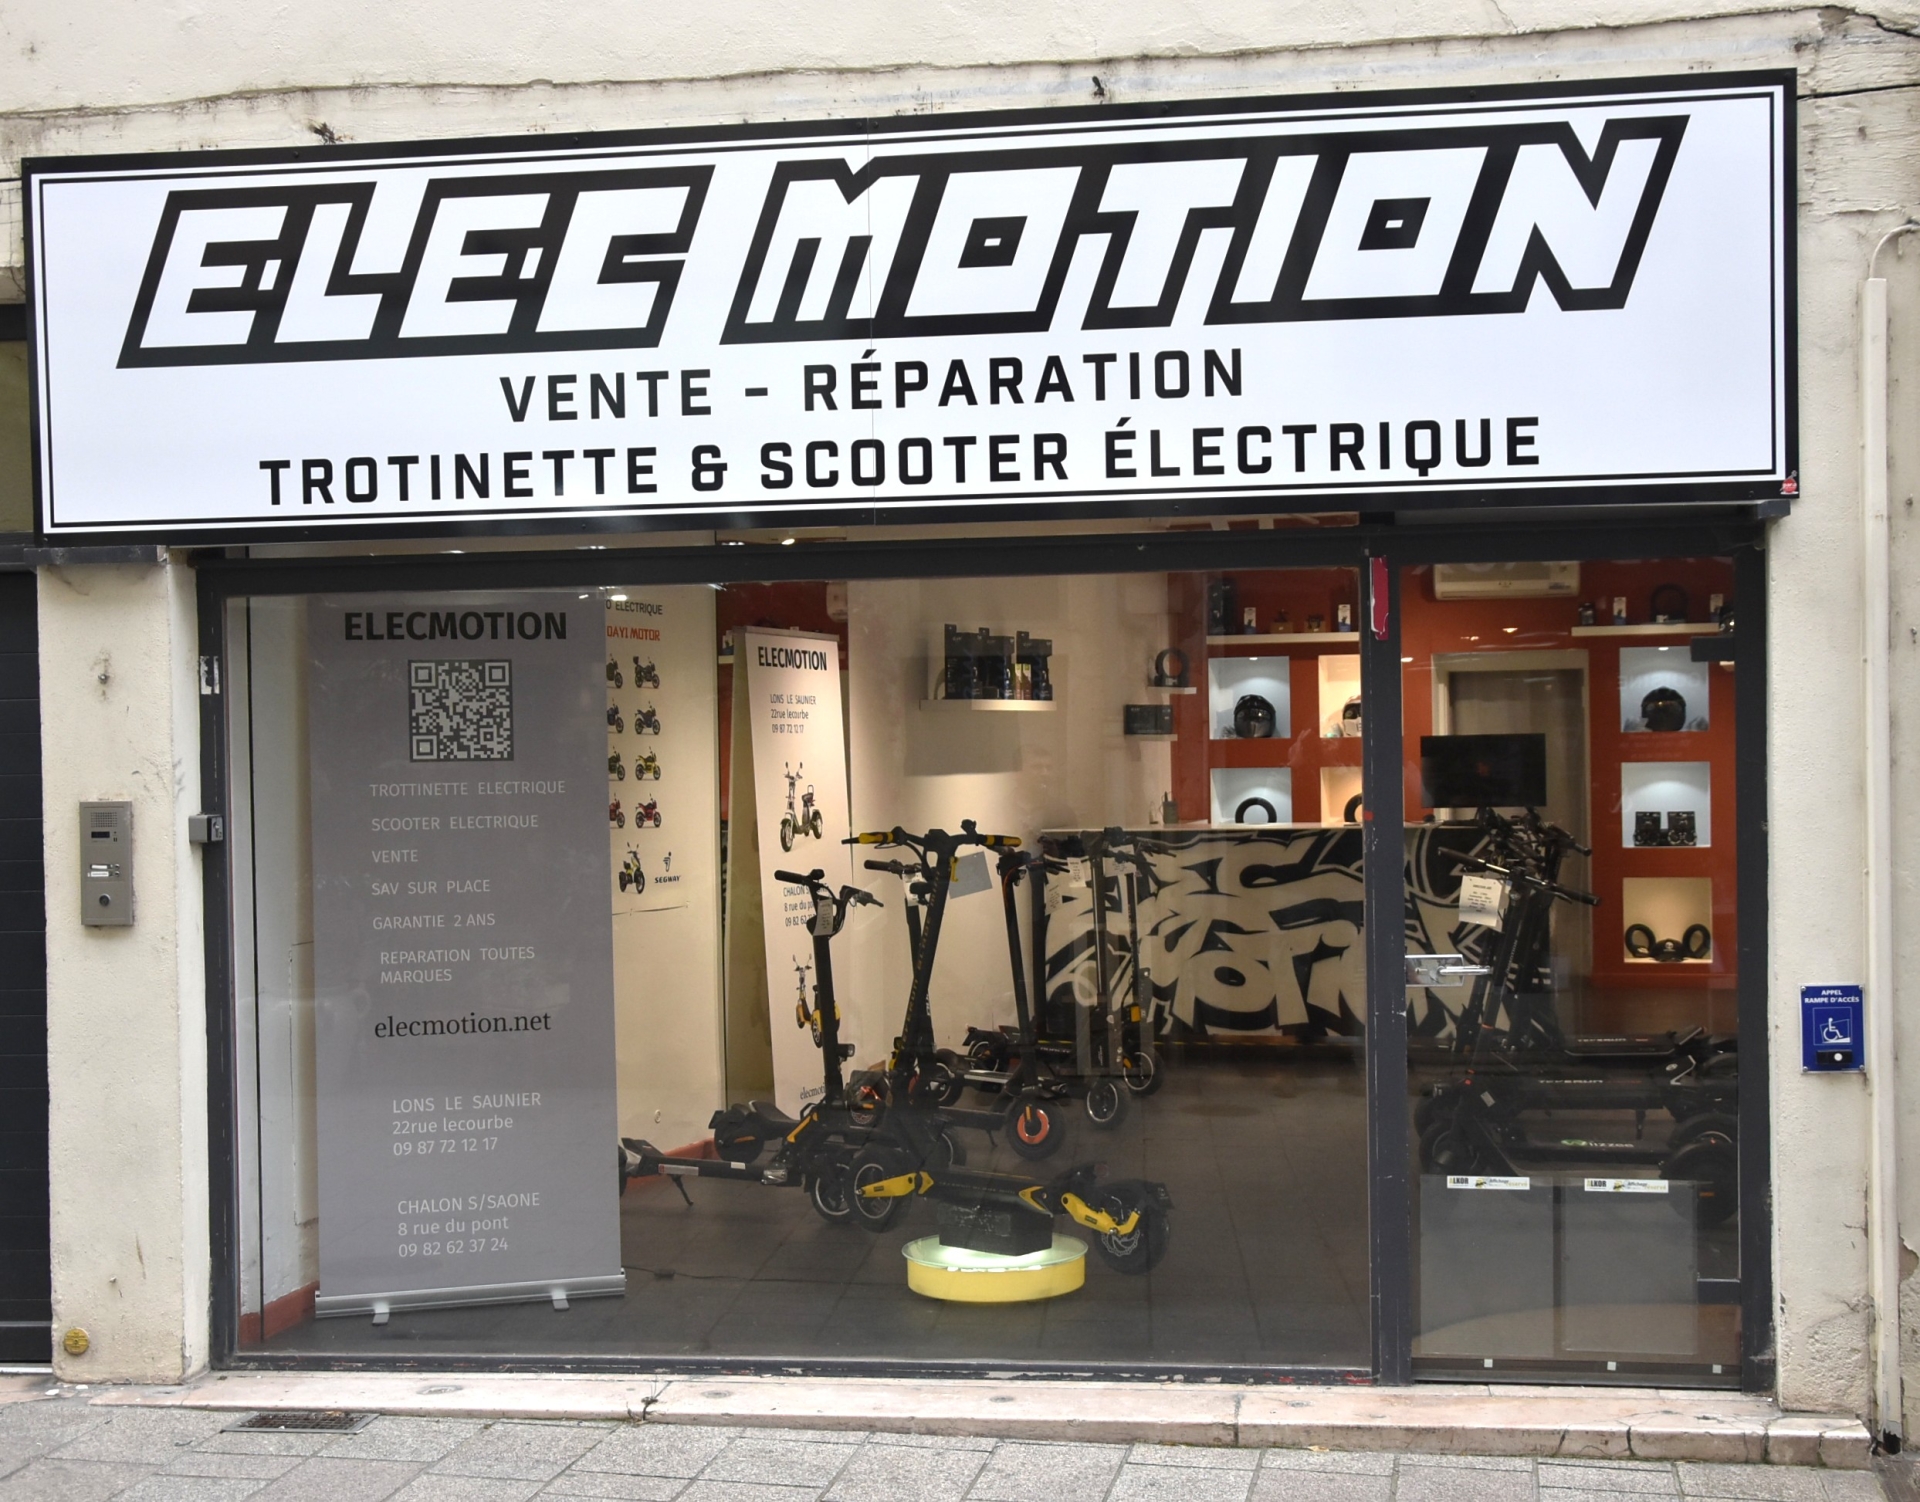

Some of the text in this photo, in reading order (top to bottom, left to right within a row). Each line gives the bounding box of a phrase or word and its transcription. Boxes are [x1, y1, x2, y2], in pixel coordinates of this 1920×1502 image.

[116, 114, 1690, 368] ELEC MOTION
[500, 348, 1243, 423] VENTE - RÉPARATION
[260, 416, 1540, 506] TROTINETTE & SCOOTER ÉLECTRIQUE
[615, 600, 663, 616] ELECTRIQUE
[345, 611, 567, 640] ELECMOTION
[630, 627, 661, 642] MOTOR
[757, 646, 828, 671] ELECMOTION
[770, 693, 817, 706] LONS LE SAUNIER
[770, 708, 809, 720] 22rue lecourbe
[370, 780, 566, 797] TROTTINETTE ELECTRIQUE
[371, 814, 539, 832] SCOOTER ELECTRIQUE
[371, 849, 419, 863] VENTE
[371, 879, 491, 896] SAV SUR PLACE
[654, 875, 680, 884] SEGWAY
[783, 885, 805, 897] CHALON
[788, 901, 798, 911] rue
[799, 899, 807, 910] du
[372, 913, 496, 930] GARANTIE 2 ANS
[380, 946, 536, 965] REPARATION TOUTES
[380, 969, 453, 984] MARQUES
[1830, 995, 1860, 1003] D'ACCÈS
[374, 1012, 552, 1038] elecmotion.net
[392, 1092, 542, 1114] LONS LE SAUNIER
[392, 1114, 514, 1135] 22rue lecourbe
[393, 1137, 498, 1156] 09 87 72 12 17
[397, 1192, 541, 1215] CHALON S/SAONE
[398, 1216, 509, 1236] 8 rue du pont
[398, 1237, 509, 1258] 09 82 62 37 24
